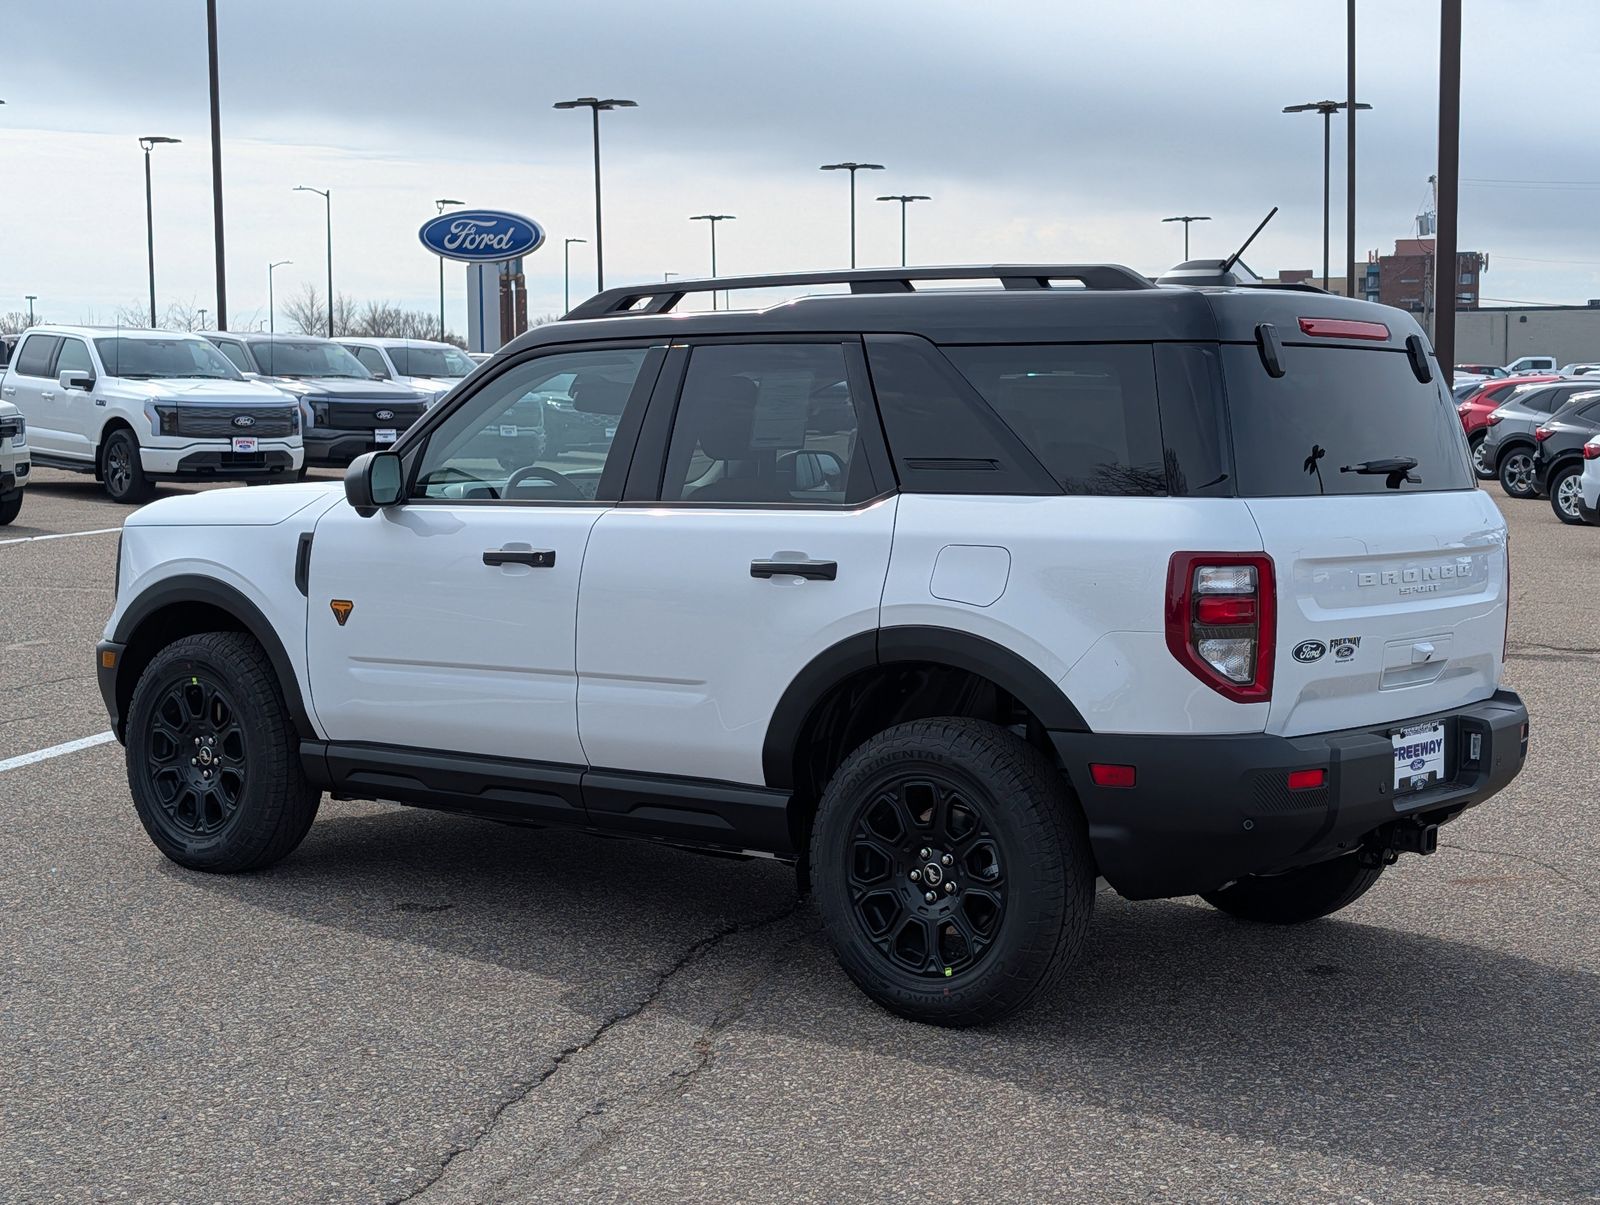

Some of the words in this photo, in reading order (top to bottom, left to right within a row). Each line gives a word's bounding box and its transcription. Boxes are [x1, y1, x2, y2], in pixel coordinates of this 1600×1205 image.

[443, 219, 516, 250] Ford
[1358, 563, 1472, 587] BRONCO
[1399, 584, 1440, 595] SPORT
[1300, 644, 1322, 659] Ford
[1329, 636, 1361, 653] FREEWAY
[1393, 738, 1442, 761] FREEWAY
